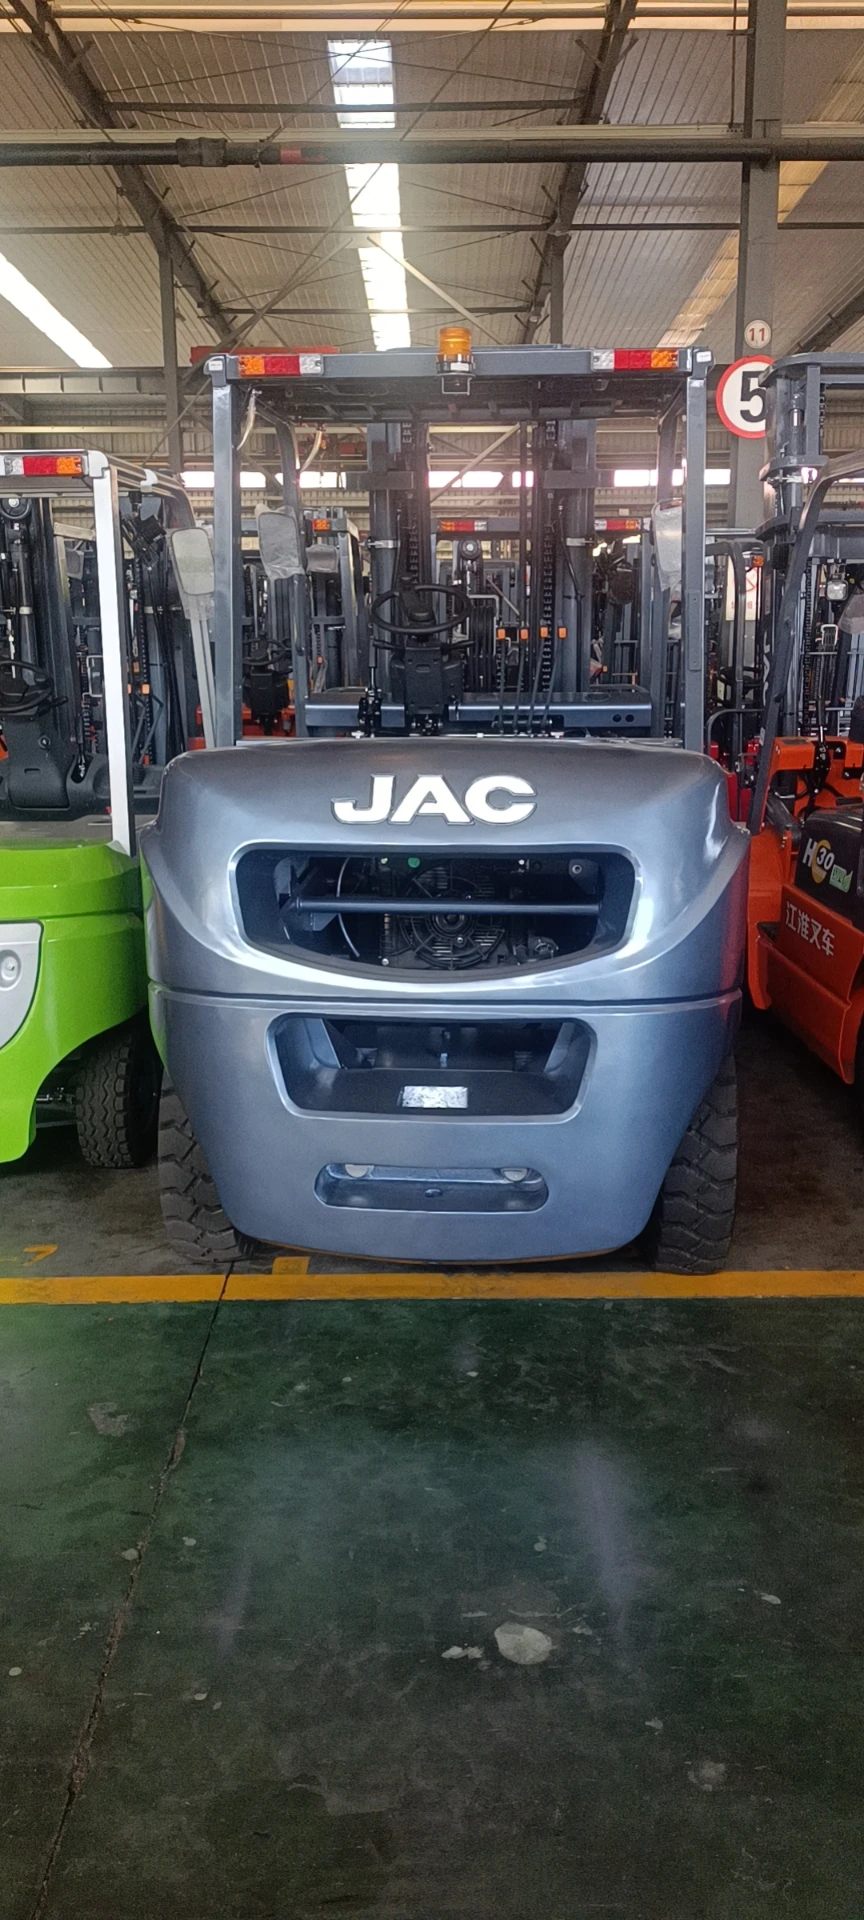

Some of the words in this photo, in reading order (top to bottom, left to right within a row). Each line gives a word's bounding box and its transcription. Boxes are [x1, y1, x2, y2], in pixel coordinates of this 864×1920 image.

[748, 327, 766, 342] 11
[739, 370, 767, 423] 5
[331, 773, 539, 826] JAC
[785, 901, 835, 957] 江淮叉车
